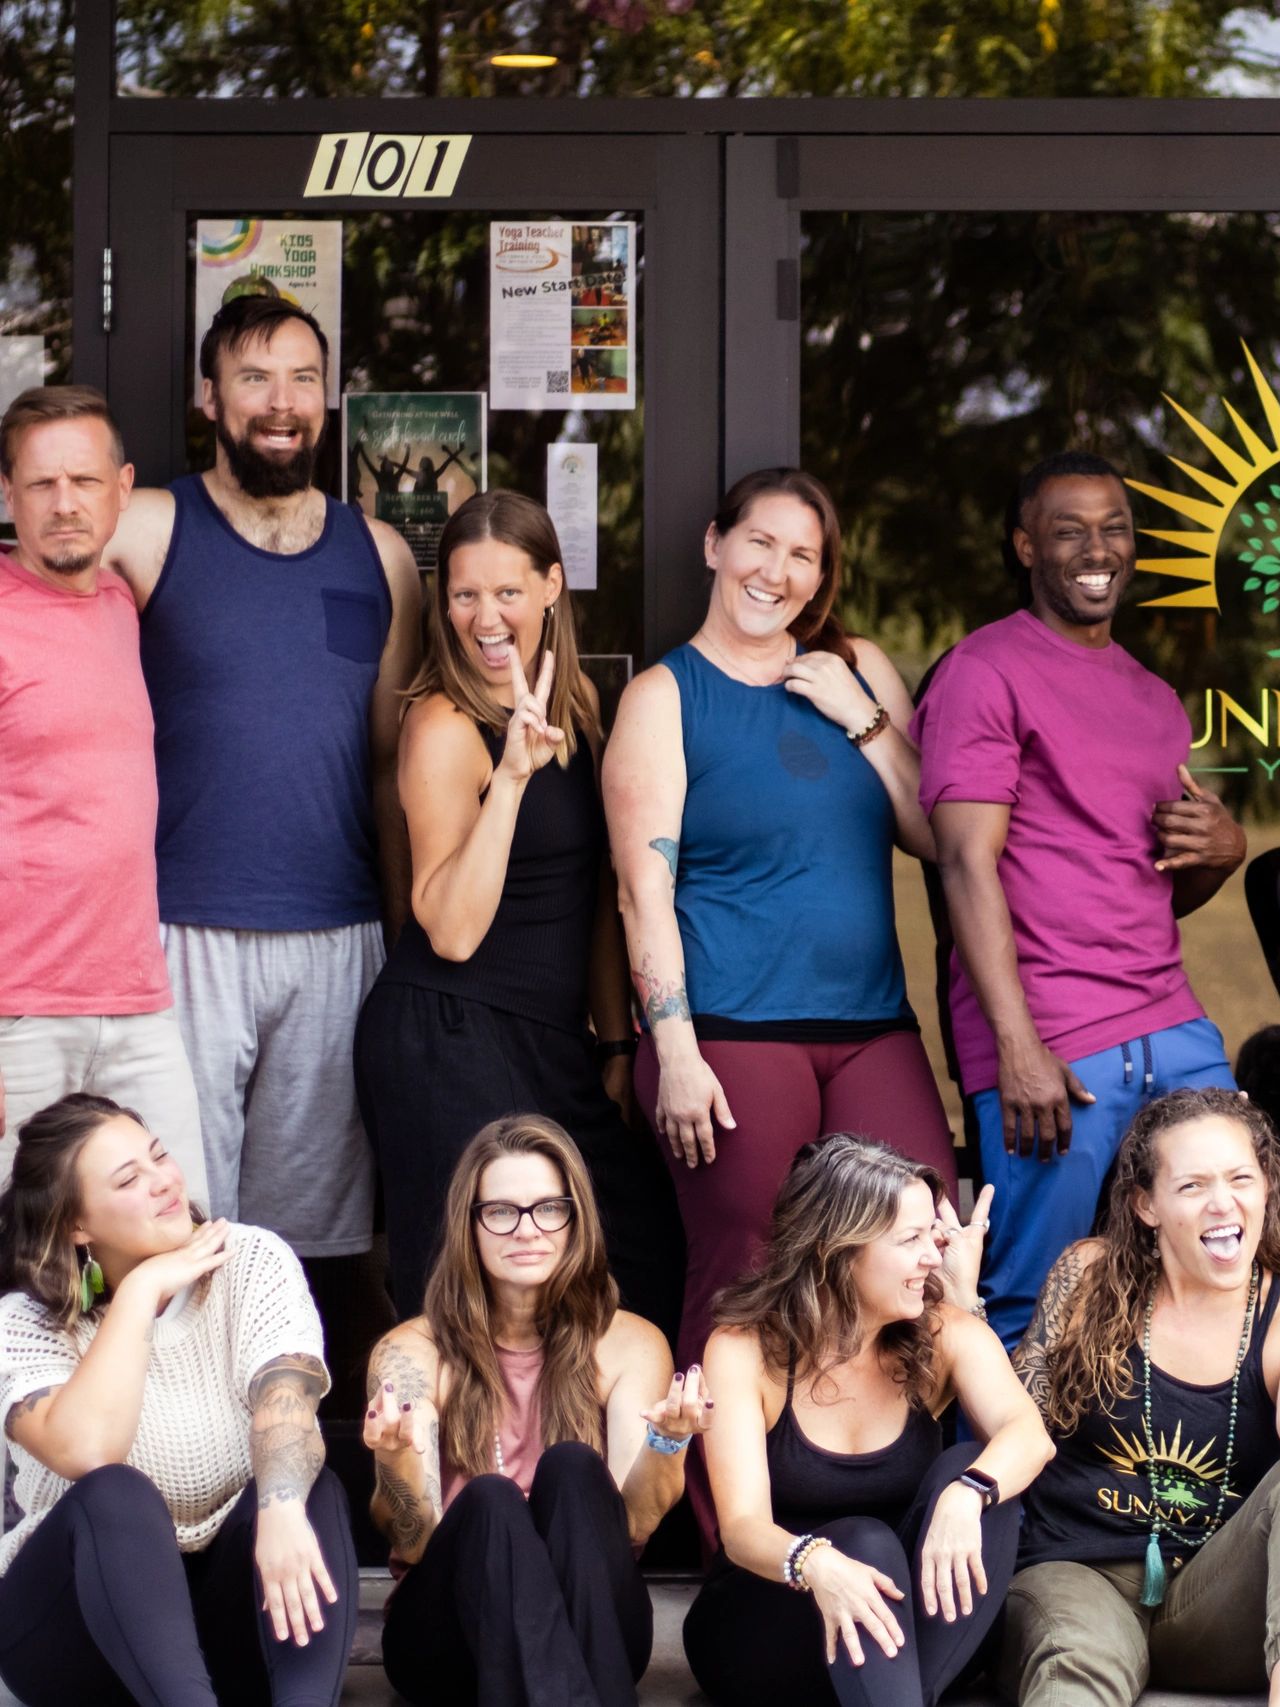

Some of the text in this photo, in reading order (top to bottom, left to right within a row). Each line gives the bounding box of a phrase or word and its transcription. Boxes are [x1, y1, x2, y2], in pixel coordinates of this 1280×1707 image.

[323, 138, 451, 192] 101
[499, 226, 564, 239] Yoga Teacher
[280, 234, 313, 247] KIDS
[499, 240, 541, 253] Training
[284, 249, 316, 262] YOGA
[250, 264, 316, 278] WORKSHOP
[502, 285, 538, 299] New
[541, 277, 581, 293] Start
[1097, 1488, 1196, 1526] SUNNY
